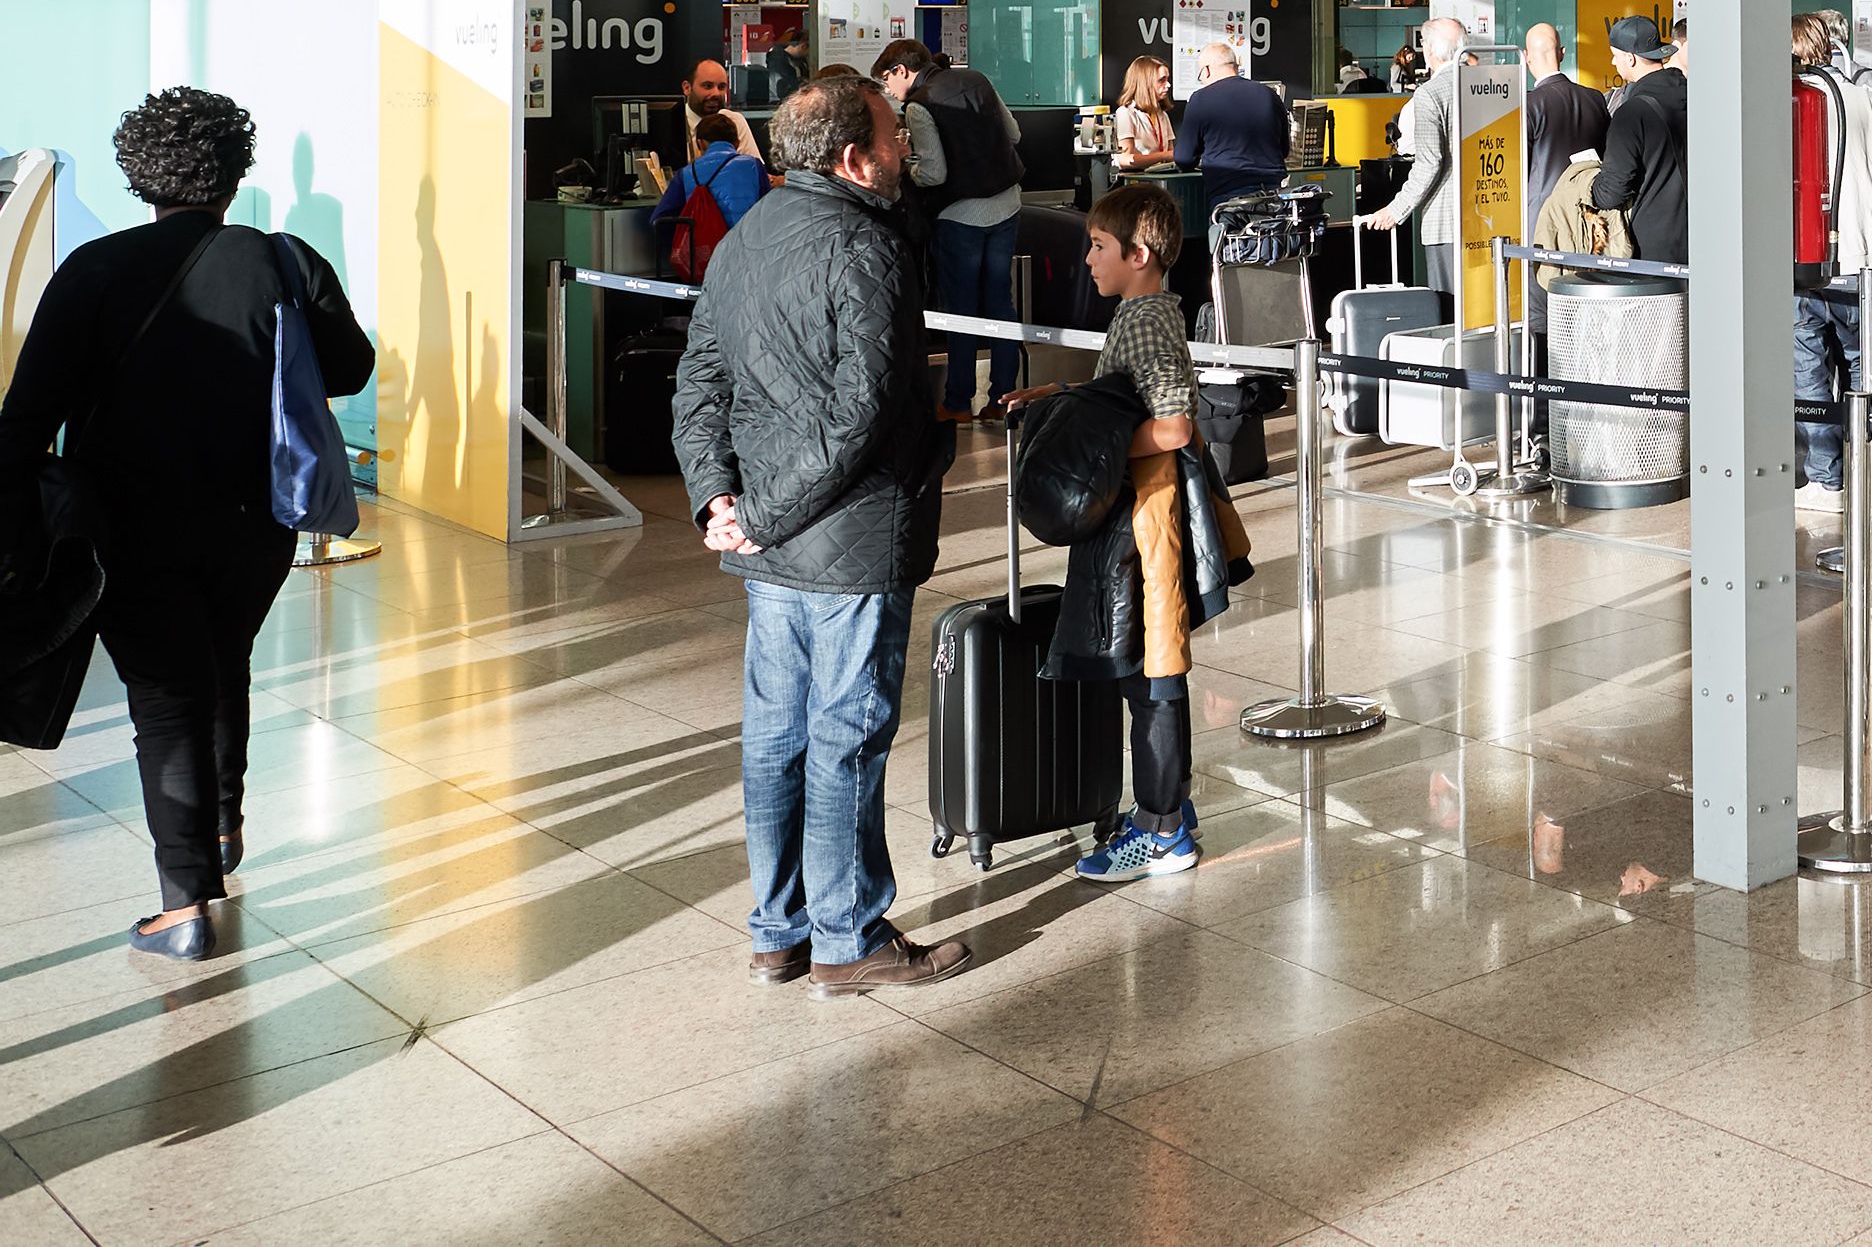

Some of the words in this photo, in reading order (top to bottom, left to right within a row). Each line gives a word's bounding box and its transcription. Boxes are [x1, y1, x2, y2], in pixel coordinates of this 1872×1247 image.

[455, 13, 499, 54] vueling
[551, 0, 663, 64] eling
[1470, 78, 1510, 99] vueling
[1479, 135, 1495, 150] MÁS
[1496, 137, 1505, 149] DE
[1479, 153, 1504, 177] 160
[1476, 178, 1508, 190] DESTINOS,
[1475, 193, 1480, 204] Y
[1481, 192, 1490, 204] EL
[1492, 191, 1510, 203] TUYO.
[1465, 239, 1492, 250] POSSIBLE
[1318, 357, 1342, 366] PRIORITY
[1397, 367, 1421, 379] vueling
[1423, 370, 1449, 379] PRIORITY
[1509, 380, 1534, 393] vueling
[1538, 384, 1565, 394] PRIORITY
[1630, 393, 1657, 405] vueling
[1662, 396, 1690, 404] PRIORITY
[1795, 406, 1826, 415] PRIORITY
